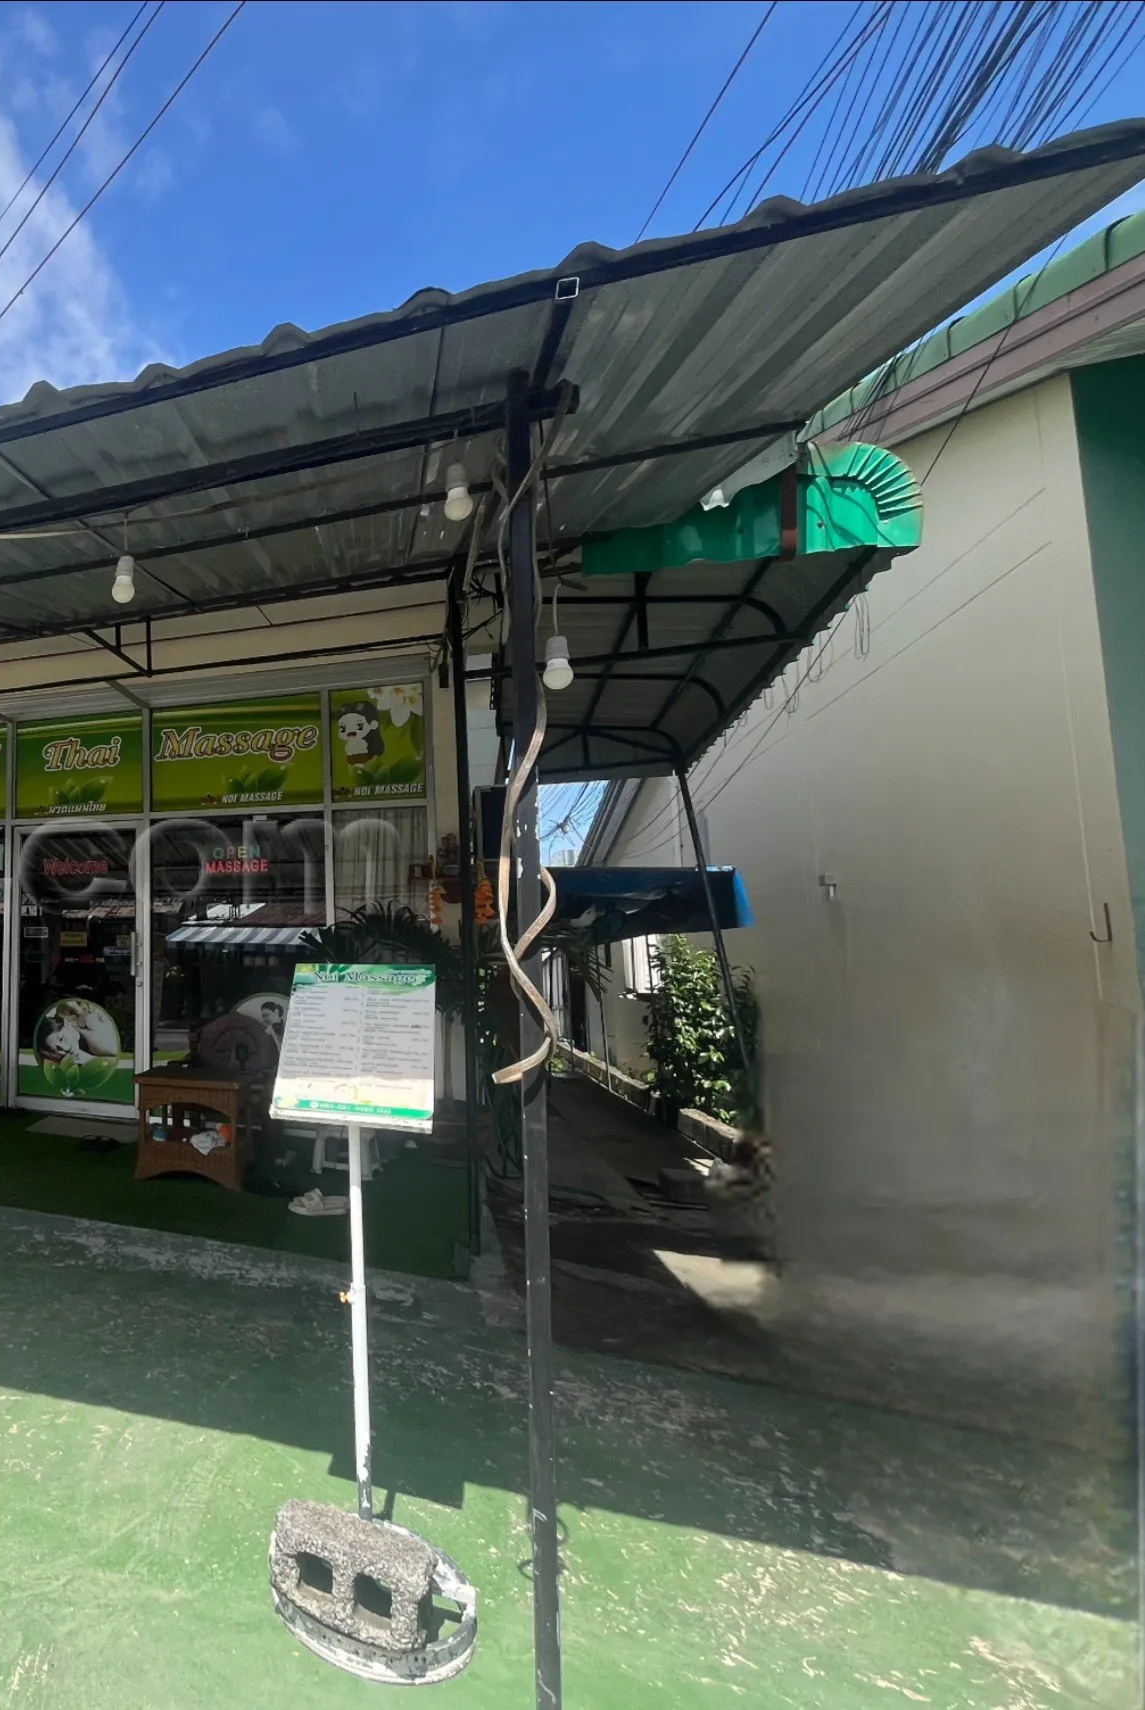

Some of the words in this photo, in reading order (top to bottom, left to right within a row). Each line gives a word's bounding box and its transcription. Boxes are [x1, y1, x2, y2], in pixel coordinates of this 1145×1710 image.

[41, 736, 122, 772] Thai
[153, 724, 320, 763] Massage
[353, 786, 371, 796] NOI
[374, 783, 424, 795] MASSAGE
[221, 794, 237, 804] NOI
[240, 791, 283, 803] MASSAGE
[212, 845, 261, 859] OPEN
[43, 857, 108, 875] Welcome
[206, 859, 269, 874] MASSAGE
